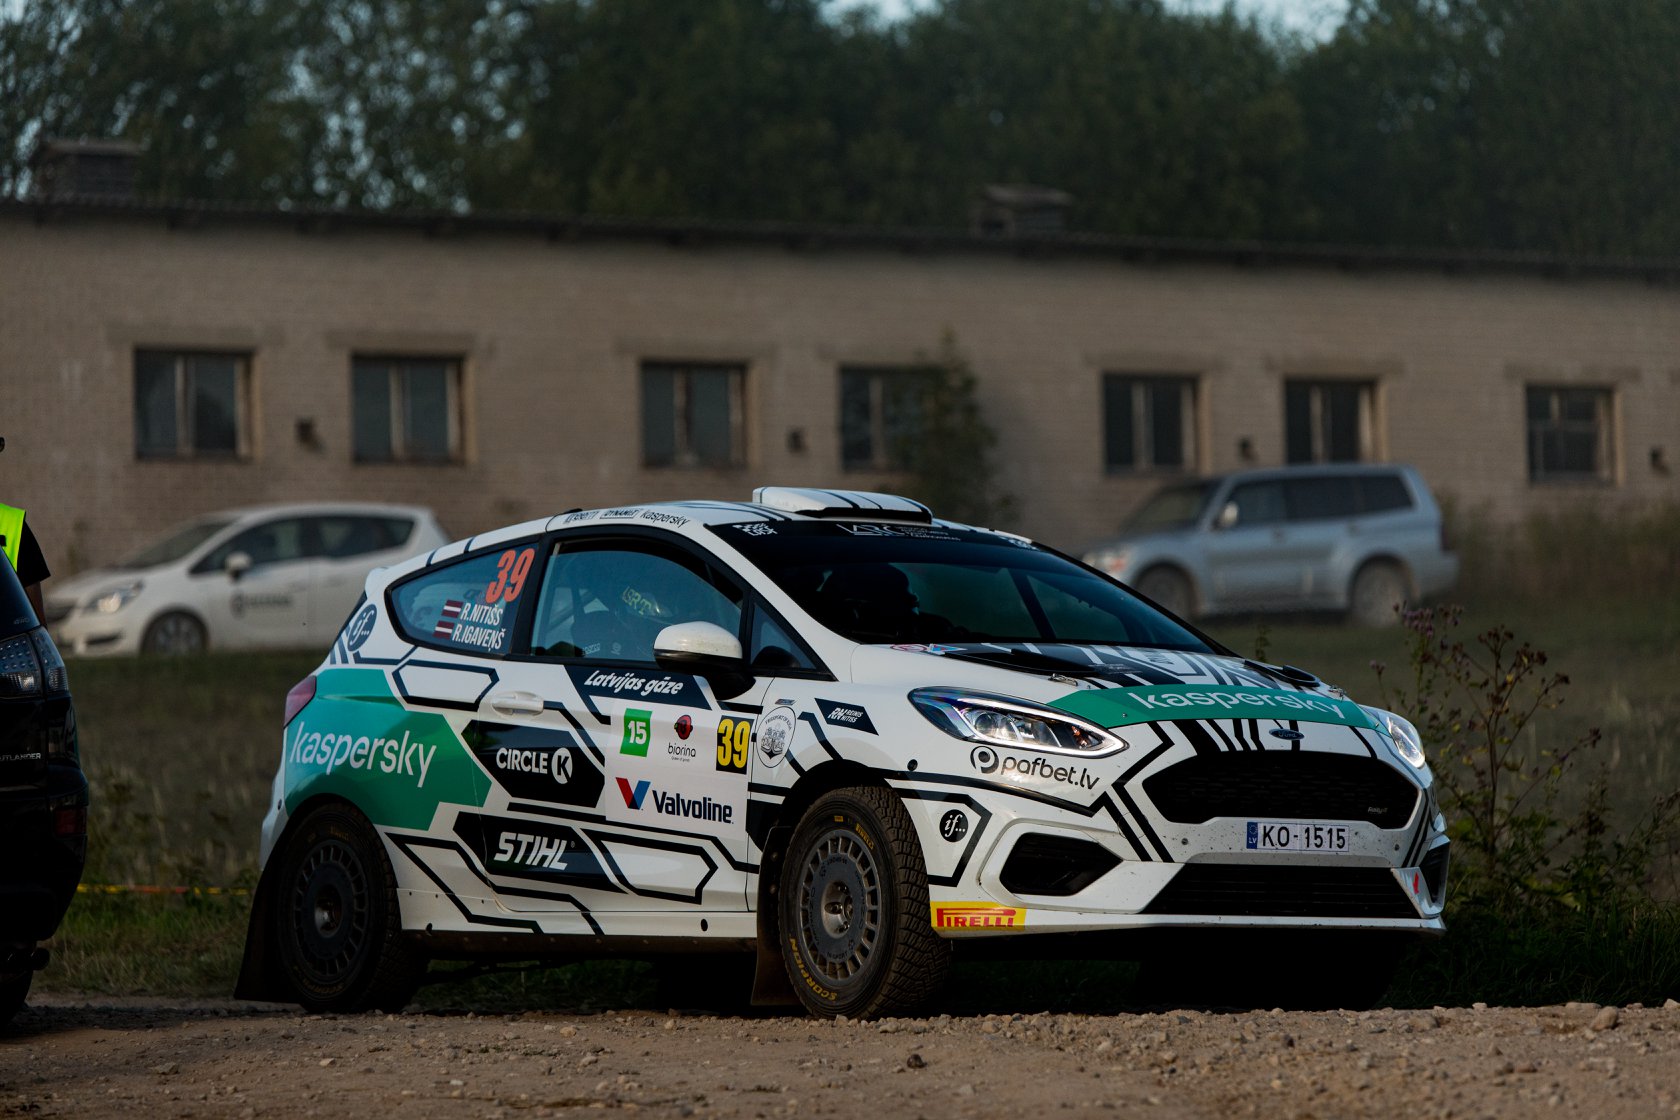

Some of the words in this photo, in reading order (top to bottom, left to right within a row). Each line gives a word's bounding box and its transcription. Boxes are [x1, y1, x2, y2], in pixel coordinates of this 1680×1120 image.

[641, 510, 691, 528] kaspersky
[485, 548, 535, 604] 39
[583, 669, 647, 694] Latvijas
[640, 676, 685, 697] gāze
[1128, 691, 1347, 720] kaspersky
[627, 720, 647, 745] 15
[717, 718, 751, 769] 39
[289, 721, 437, 788] kaspersky
[495, 747, 549, 775] CIRCLE
[554, 750, 571, 783] K
[1001, 756, 1100, 790] pafbet.lv
[652, 790, 733, 824] Valvoline
[944, 814, 965, 838] if...
[493, 831, 568, 871] STIHL
[936, 908, 1016, 928] PIRELLI
